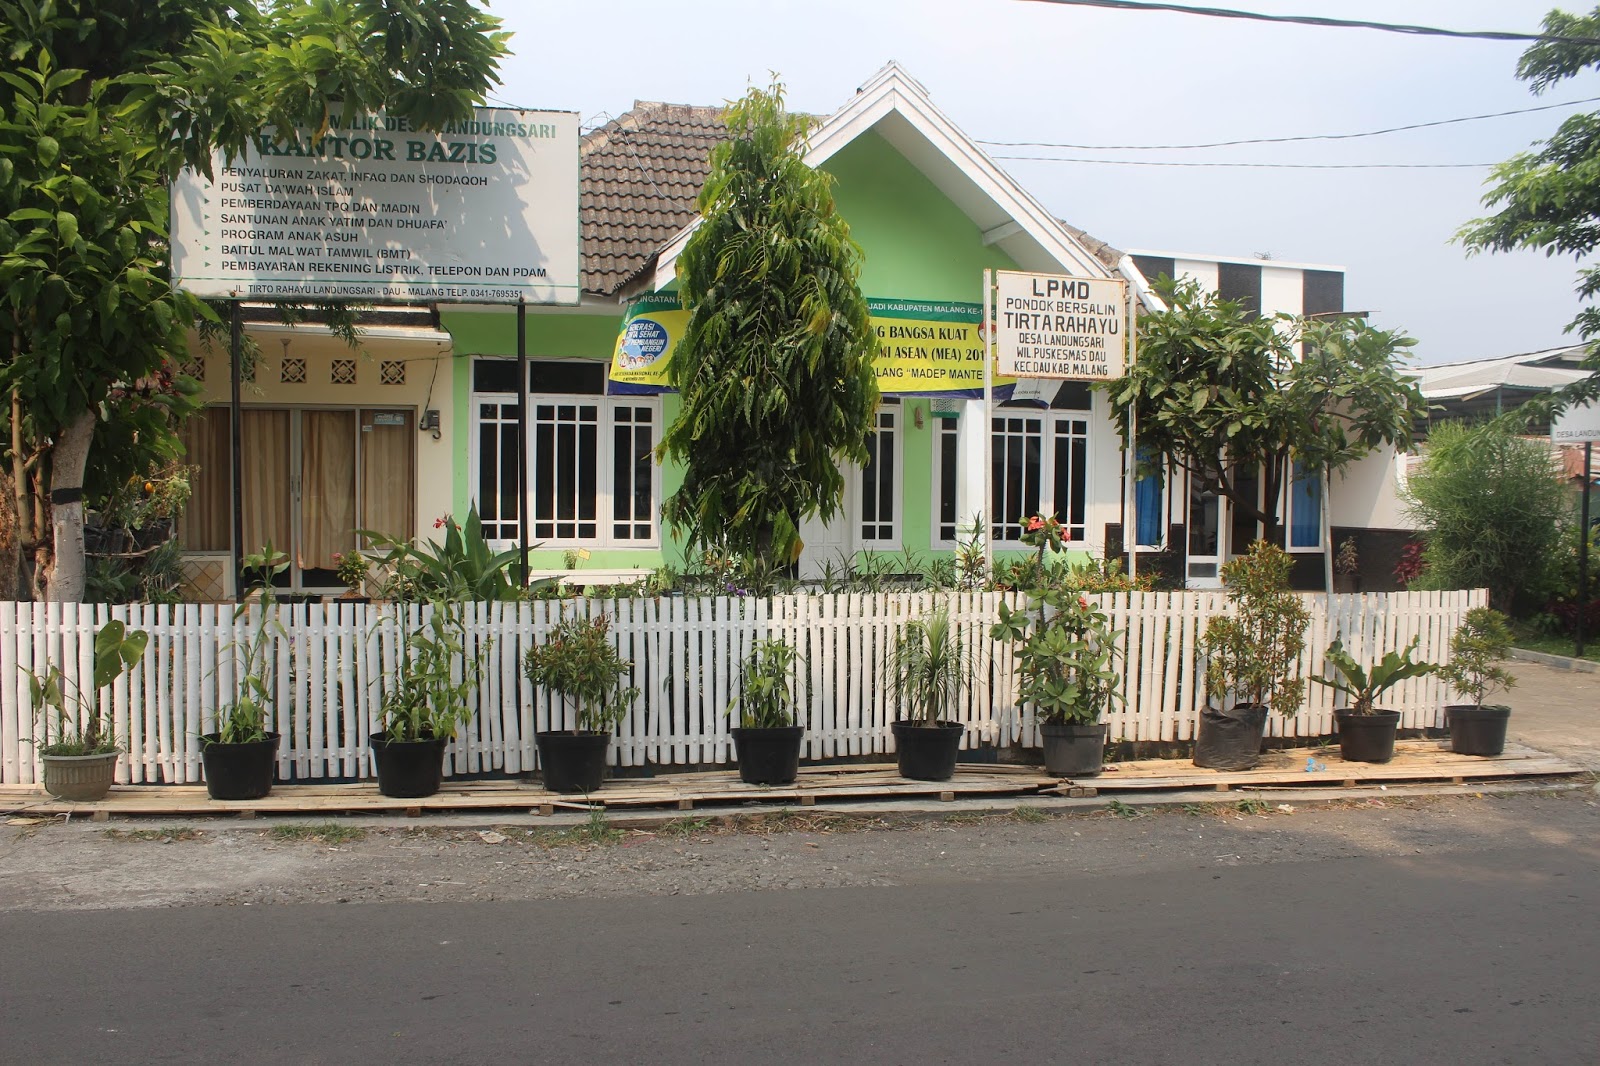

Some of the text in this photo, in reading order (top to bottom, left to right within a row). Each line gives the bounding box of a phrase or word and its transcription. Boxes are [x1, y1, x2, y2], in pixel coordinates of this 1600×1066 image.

[441, 119, 556, 138] ANDUNGSARI
[260, 134, 497, 165] KANTOR BAZIS
[221, 167, 488, 186] PENYALURAN ZAKAT, INFAQ DAN SHODAQOH
[221, 182, 354, 196] PUSAT DA'WAH ISLAM
[221, 198, 420, 214] PEMBERDAYAAN TPQ DAN MADIN
[221, 214, 448, 229] SANTUNAN ANAK YATIM DAN DHUAFA'
[221, 229, 358, 242] PROGRAM ANAK ASUH
[221, 245, 411, 260] BAITUL MAL WAT TAMWIL (BMT)
[221, 261, 547, 277] PEMBAYARAN REKENING LISTRIK, TELEPON DAN PDAM
[234, 285, 246, 294] JL.
[248, 285, 274, 294] TIRTO
[276, 285, 311, 294] RAHAYU
[313, 286, 376, 295] LANDUNGSARI
[383, 287, 402, 296] DAU
[408, 288, 444, 297] MALANG
[446, 288, 469, 297] TELP.
[470, 289, 523, 299] 0341-7695351
[1033, 279, 1090, 299] LPMD
[887, 304, 932, 312] KABUPATEN
[934, 305, 966, 314] MALANG
[1006, 298, 1116, 315] PONDOK BERSALIN
[1004, 312, 1118, 335] TIRTA RAHAYU
[639, 330, 660, 338] SEHAT
[889, 326, 935, 339] BANGSA
[938, 328, 968, 341] KUAT
[1019, 333, 1104, 348] DESA LANDUNGSARI
[894, 347, 928, 360] ASEAN
[931, 348, 962, 362] (MEA)
[1089, 351, 1106, 362] DAU
